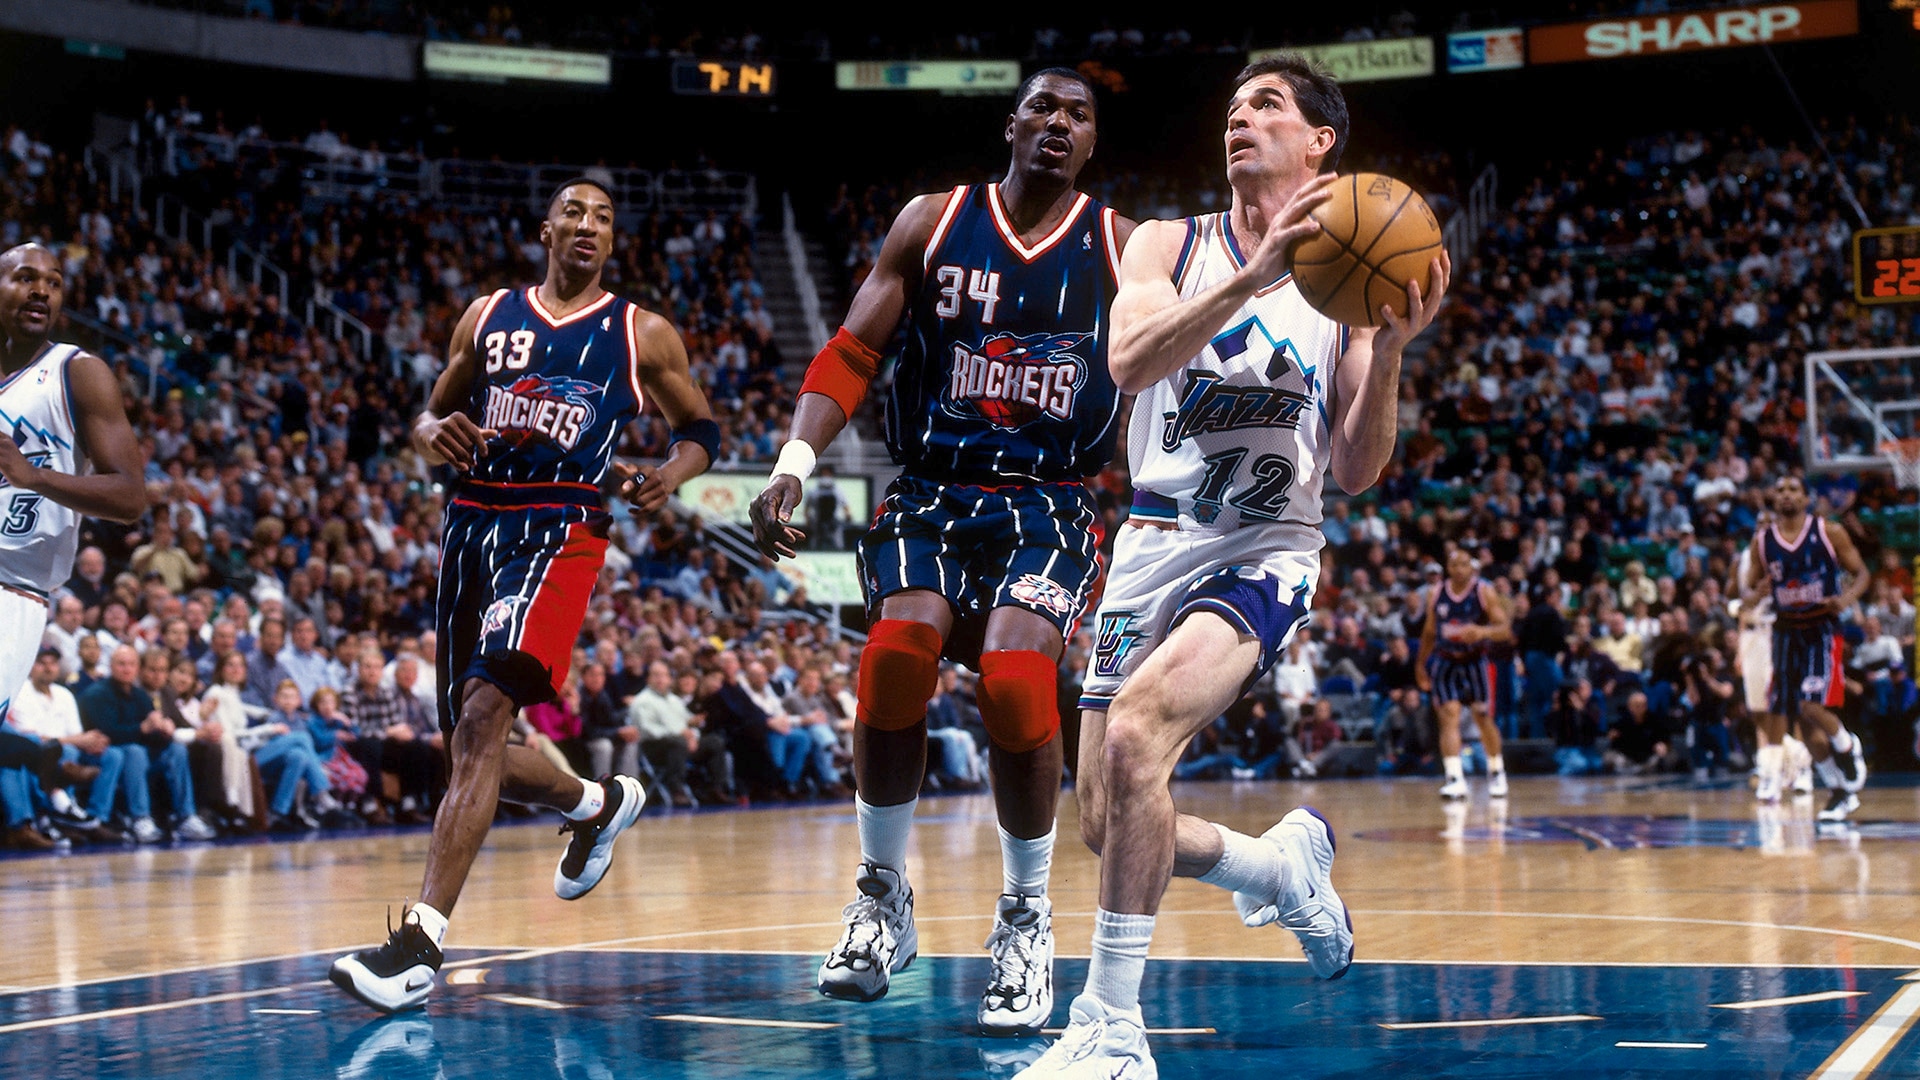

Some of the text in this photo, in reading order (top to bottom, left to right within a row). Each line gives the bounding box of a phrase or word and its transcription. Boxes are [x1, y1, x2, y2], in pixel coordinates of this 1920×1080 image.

[1584, 6, 1800, 57] SHARP
[936, 265, 1002, 324] 34
[1873, 258, 1920, 297] 22
[485, 329, 536, 375] 33
[950, 346, 1077, 419] ROCKETS
[483, 385, 588, 451] ROCKETS
[1192, 447, 1296, 519] 12
[1, 493, 44, 537] 3
